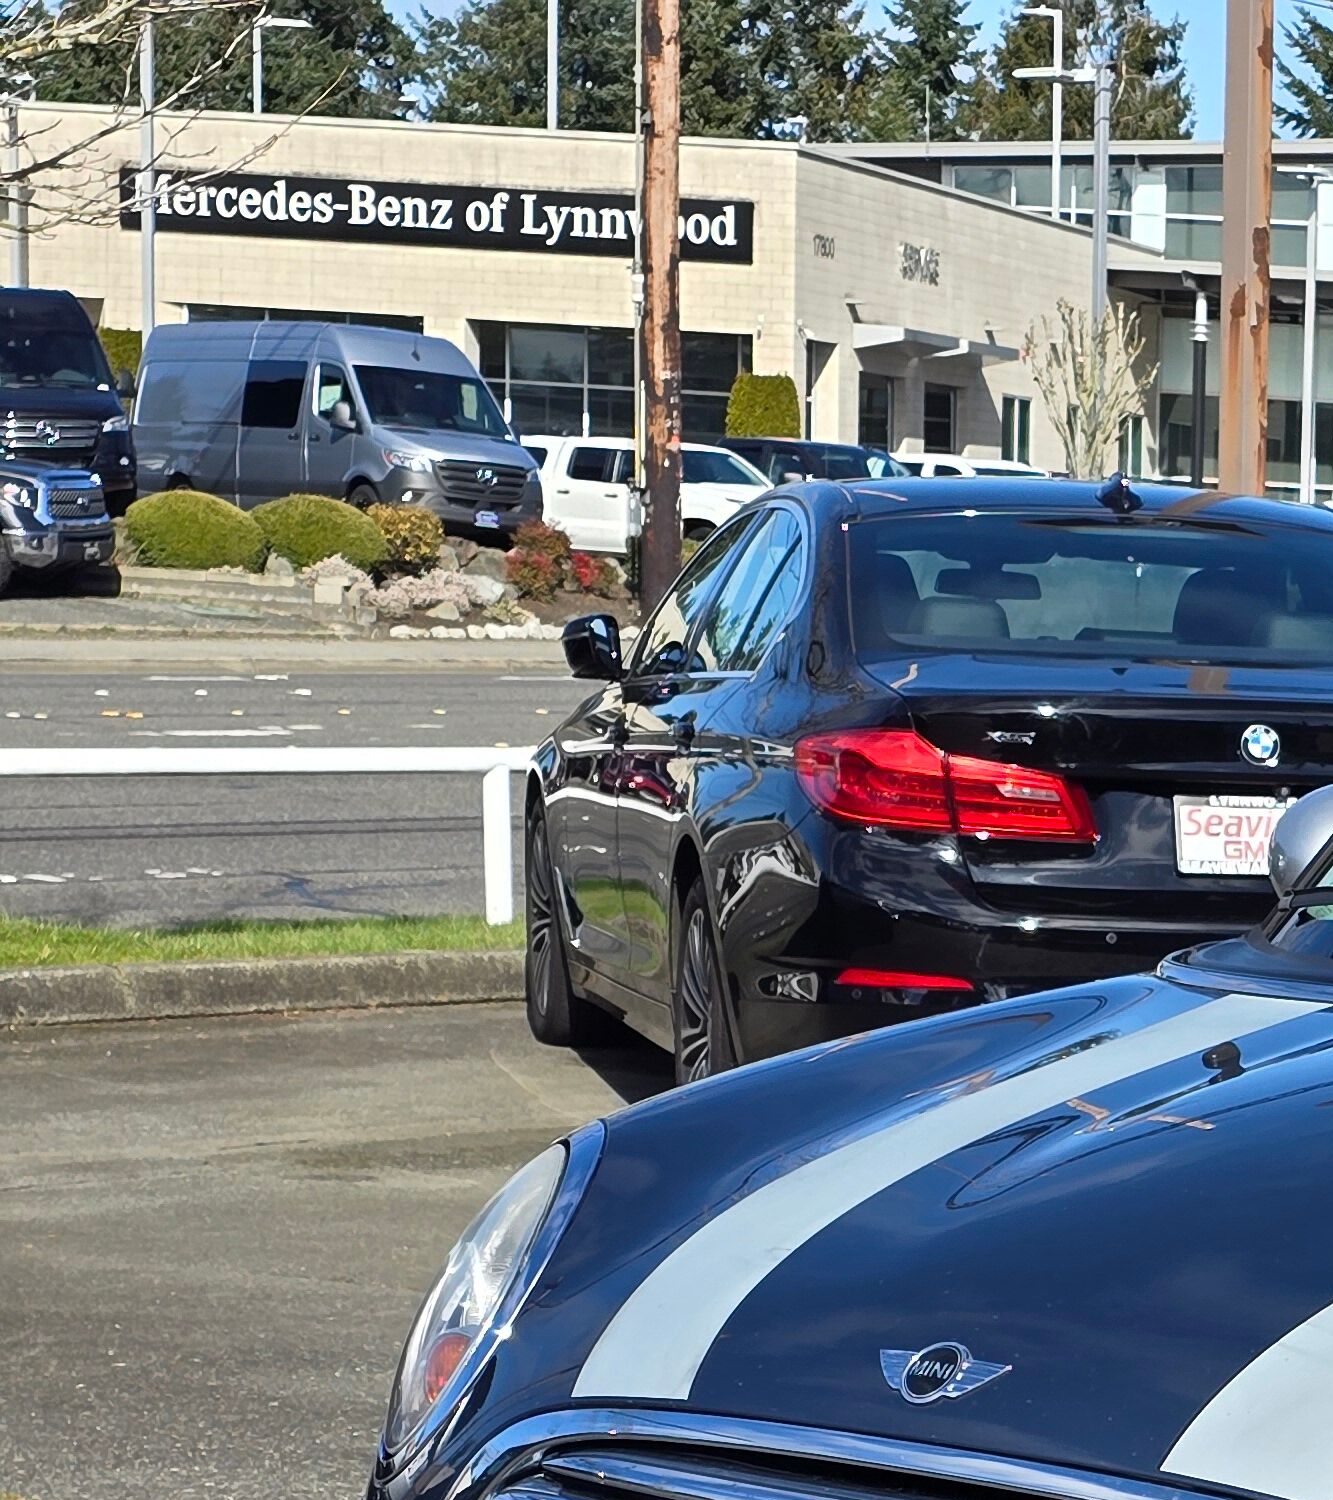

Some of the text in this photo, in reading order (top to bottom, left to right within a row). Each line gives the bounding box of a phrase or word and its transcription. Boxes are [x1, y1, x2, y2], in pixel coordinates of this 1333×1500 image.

[130, 172, 738, 246] Mercedes-Benz of Lynnod
[1183, 808, 1274, 837] Seavi
[1223, 840, 1266, 860] GM
[909, 1360, 955, 1380] MINI
